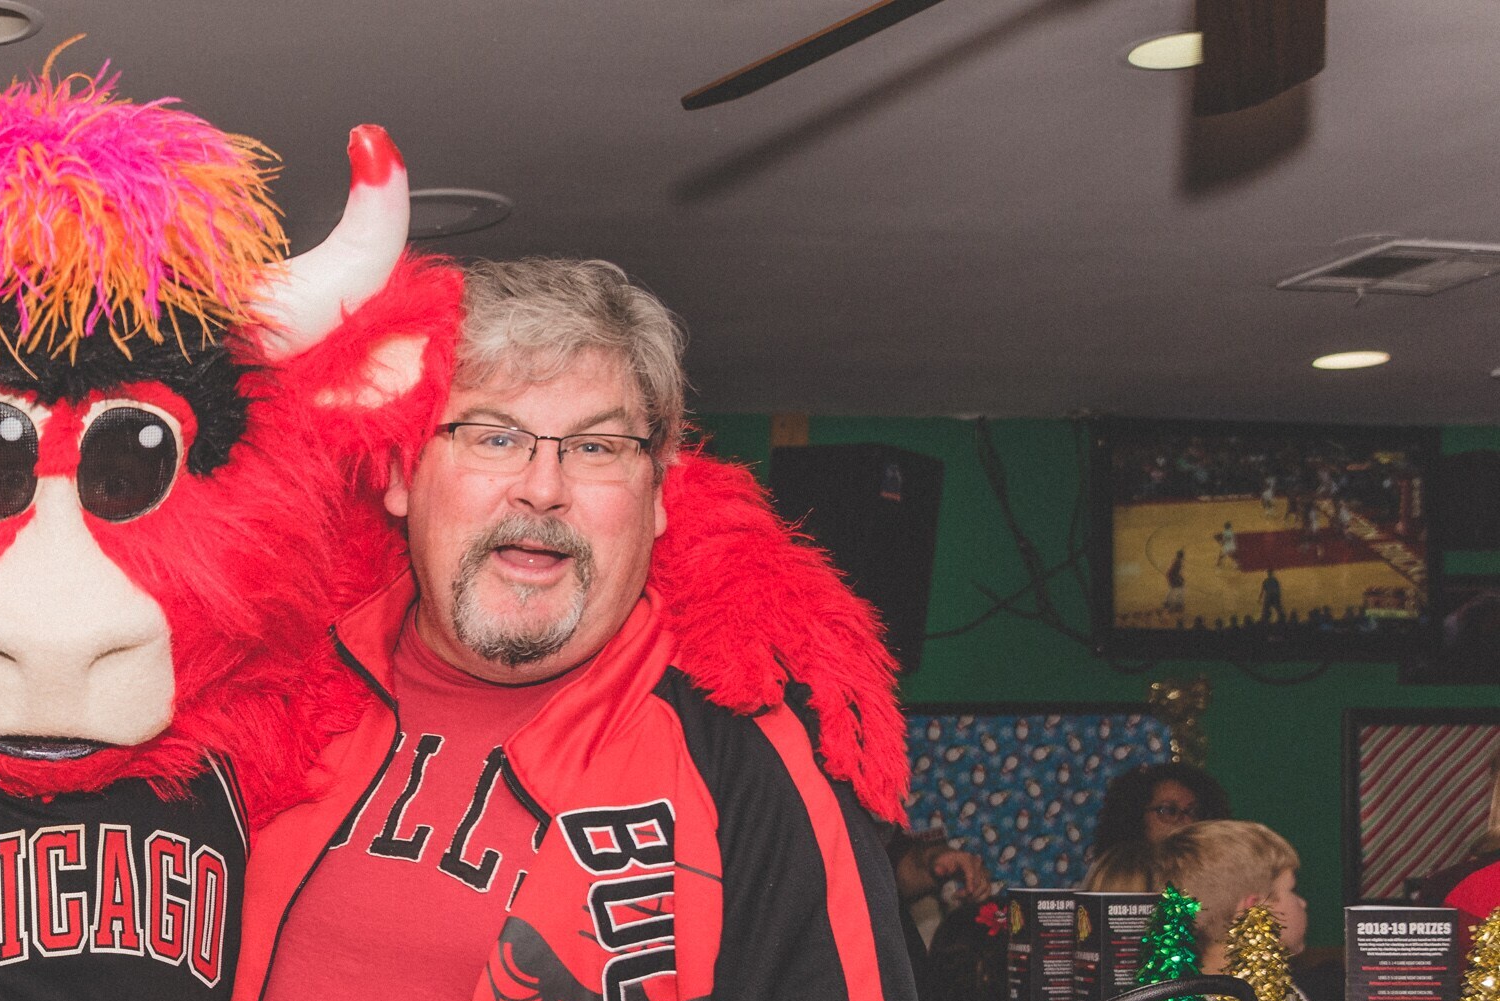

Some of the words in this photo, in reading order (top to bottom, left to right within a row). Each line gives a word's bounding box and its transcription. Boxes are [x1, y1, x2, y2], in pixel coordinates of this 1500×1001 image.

[1108, 904, 1138, 916] 2018-19
[1357, 922, 1407, 935] 2018-19
[1408, 922, 1452, 935] PRIZES
